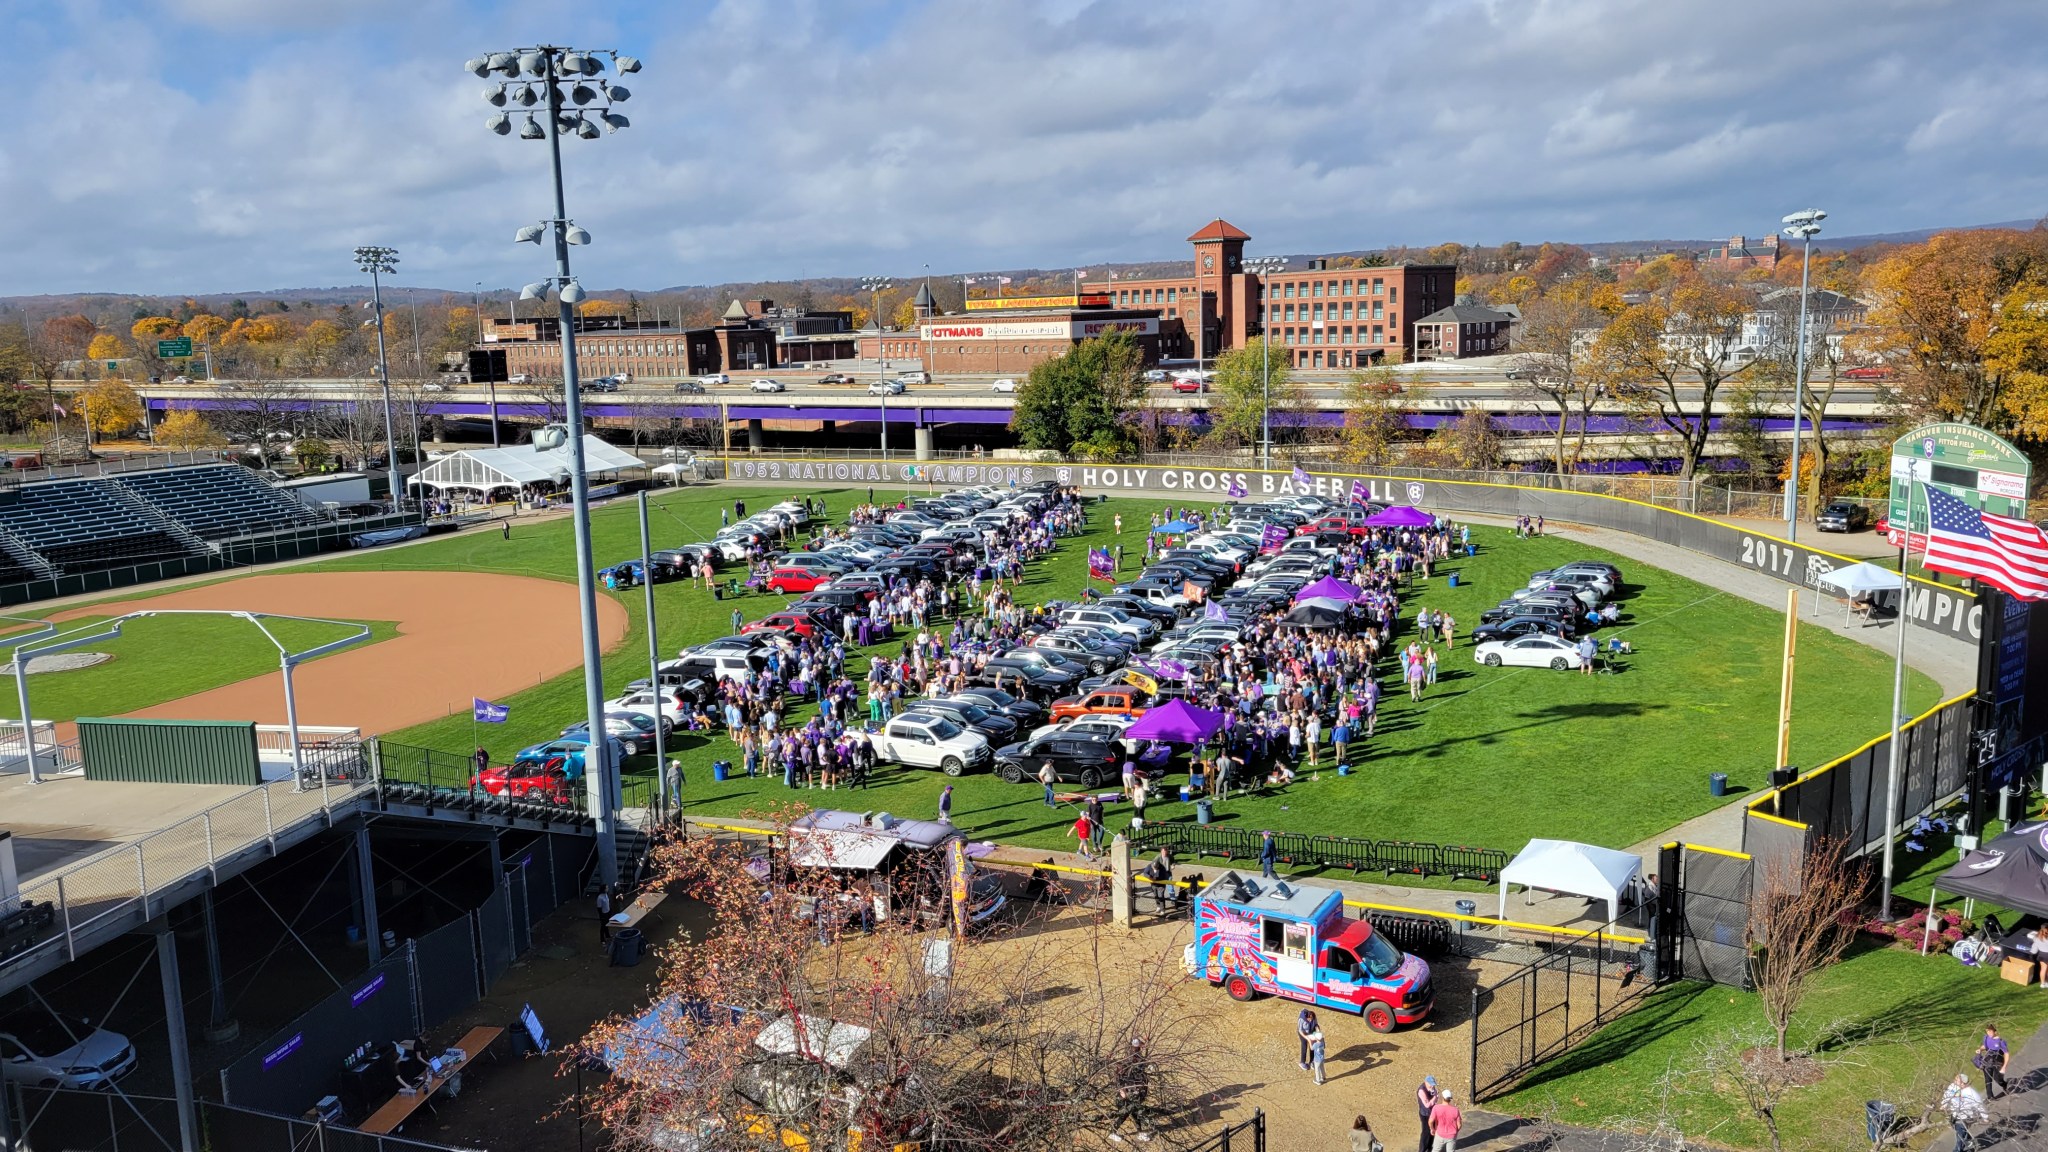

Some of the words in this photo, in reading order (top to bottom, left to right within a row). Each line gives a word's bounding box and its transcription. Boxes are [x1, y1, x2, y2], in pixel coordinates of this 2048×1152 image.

[1084, 321, 1147, 334] ROMANS
[1905, 426, 1940, 443] HANOVER
[1943, 425, 1988, 443] INSURANCE
[1990, 439, 2012, 458] PARK
[1959, 440, 1975, 449] FIELD
[733, 462, 781, 478] 1952
[789, 463, 891, 480] NATIONAL
[900, 465, 1034, 484] CHAMPIONS
[1083, 469, 1150, 487] HOLY
[1162, 470, 1248, 491] CROSS
[1262, 474, 1395, 501] BASEBLL
[1741, 536, 1794, 576] 2017
[1805, 575, 1836, 593] LEAGUE
[1979, 732, 1996, 764] 25
